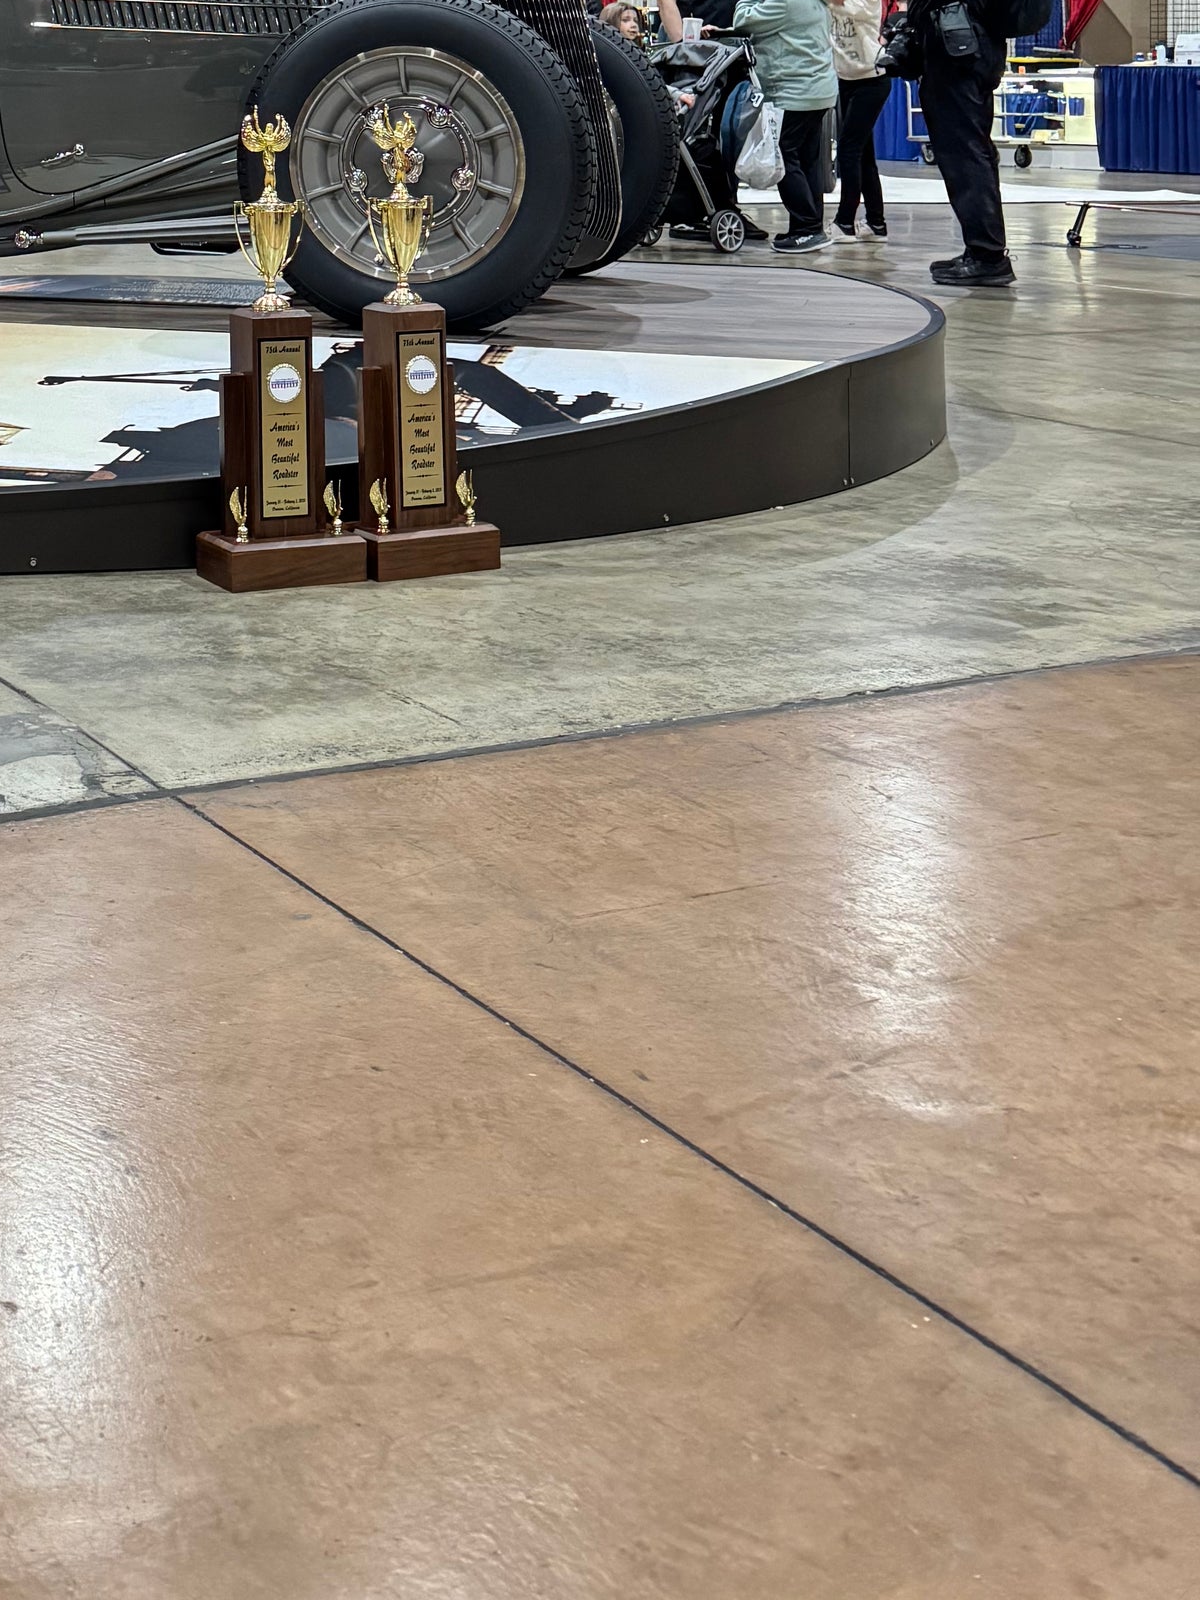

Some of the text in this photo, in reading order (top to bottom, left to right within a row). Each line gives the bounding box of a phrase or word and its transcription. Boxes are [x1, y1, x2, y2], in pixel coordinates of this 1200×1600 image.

[407, 411, 436, 423] America's
[269, 420, 300, 432] America's
[414, 428, 430, 438] Most
[276, 437, 294, 447] Most
[409, 442, 436, 455] Beautiful
[271, 452, 300, 465] Beautiful
[411, 458, 435, 470] Roadster
[272, 468, 299, 480] Roadster
